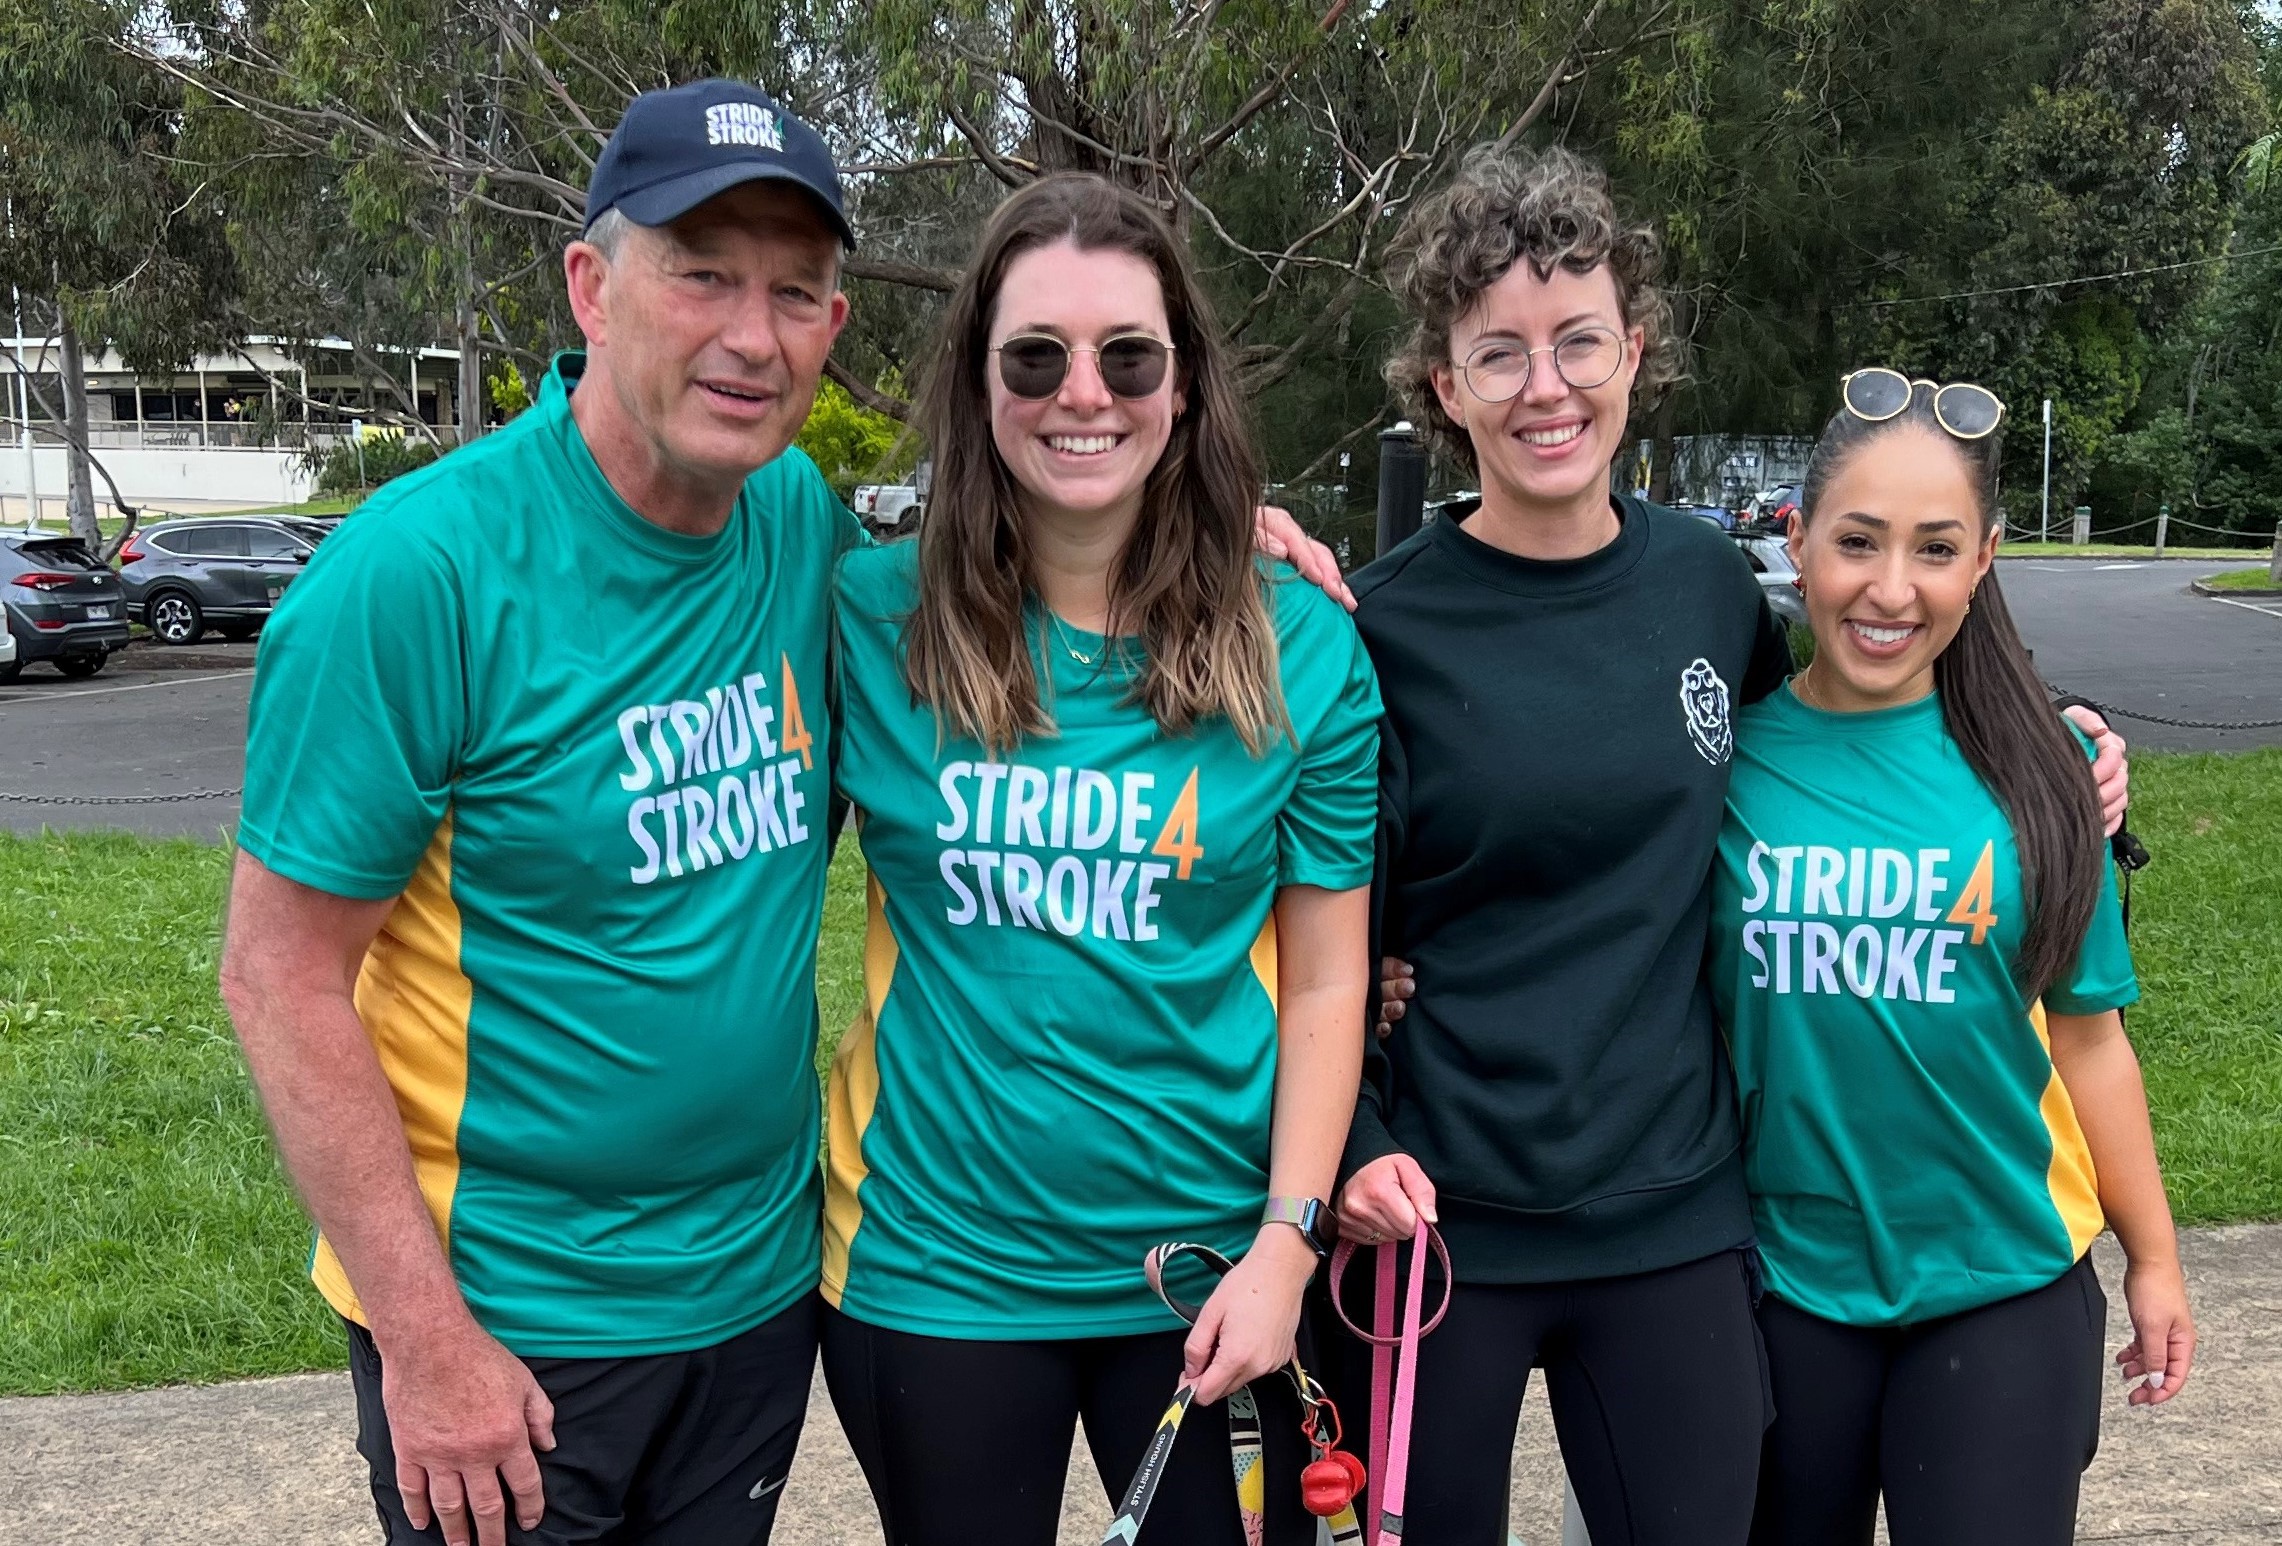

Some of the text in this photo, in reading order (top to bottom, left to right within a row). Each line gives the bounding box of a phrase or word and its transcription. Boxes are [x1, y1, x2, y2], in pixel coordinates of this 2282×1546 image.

[705, 102, 774, 131] STRIDE
[707, 122, 784, 152] STROKE
[617, 650, 813, 792] STRIDE 4
[628, 758, 809, 885] STROKE
[936, 760, 1205, 880] STRIDE 4
[939, 848, 1171, 942] STROKE
[1741, 838, 1998, 944] STRIDE 4
[1742, 919, 1965, 1003] STROKE
[1130, 1433, 1166, 1507] STYLISH HOUND
